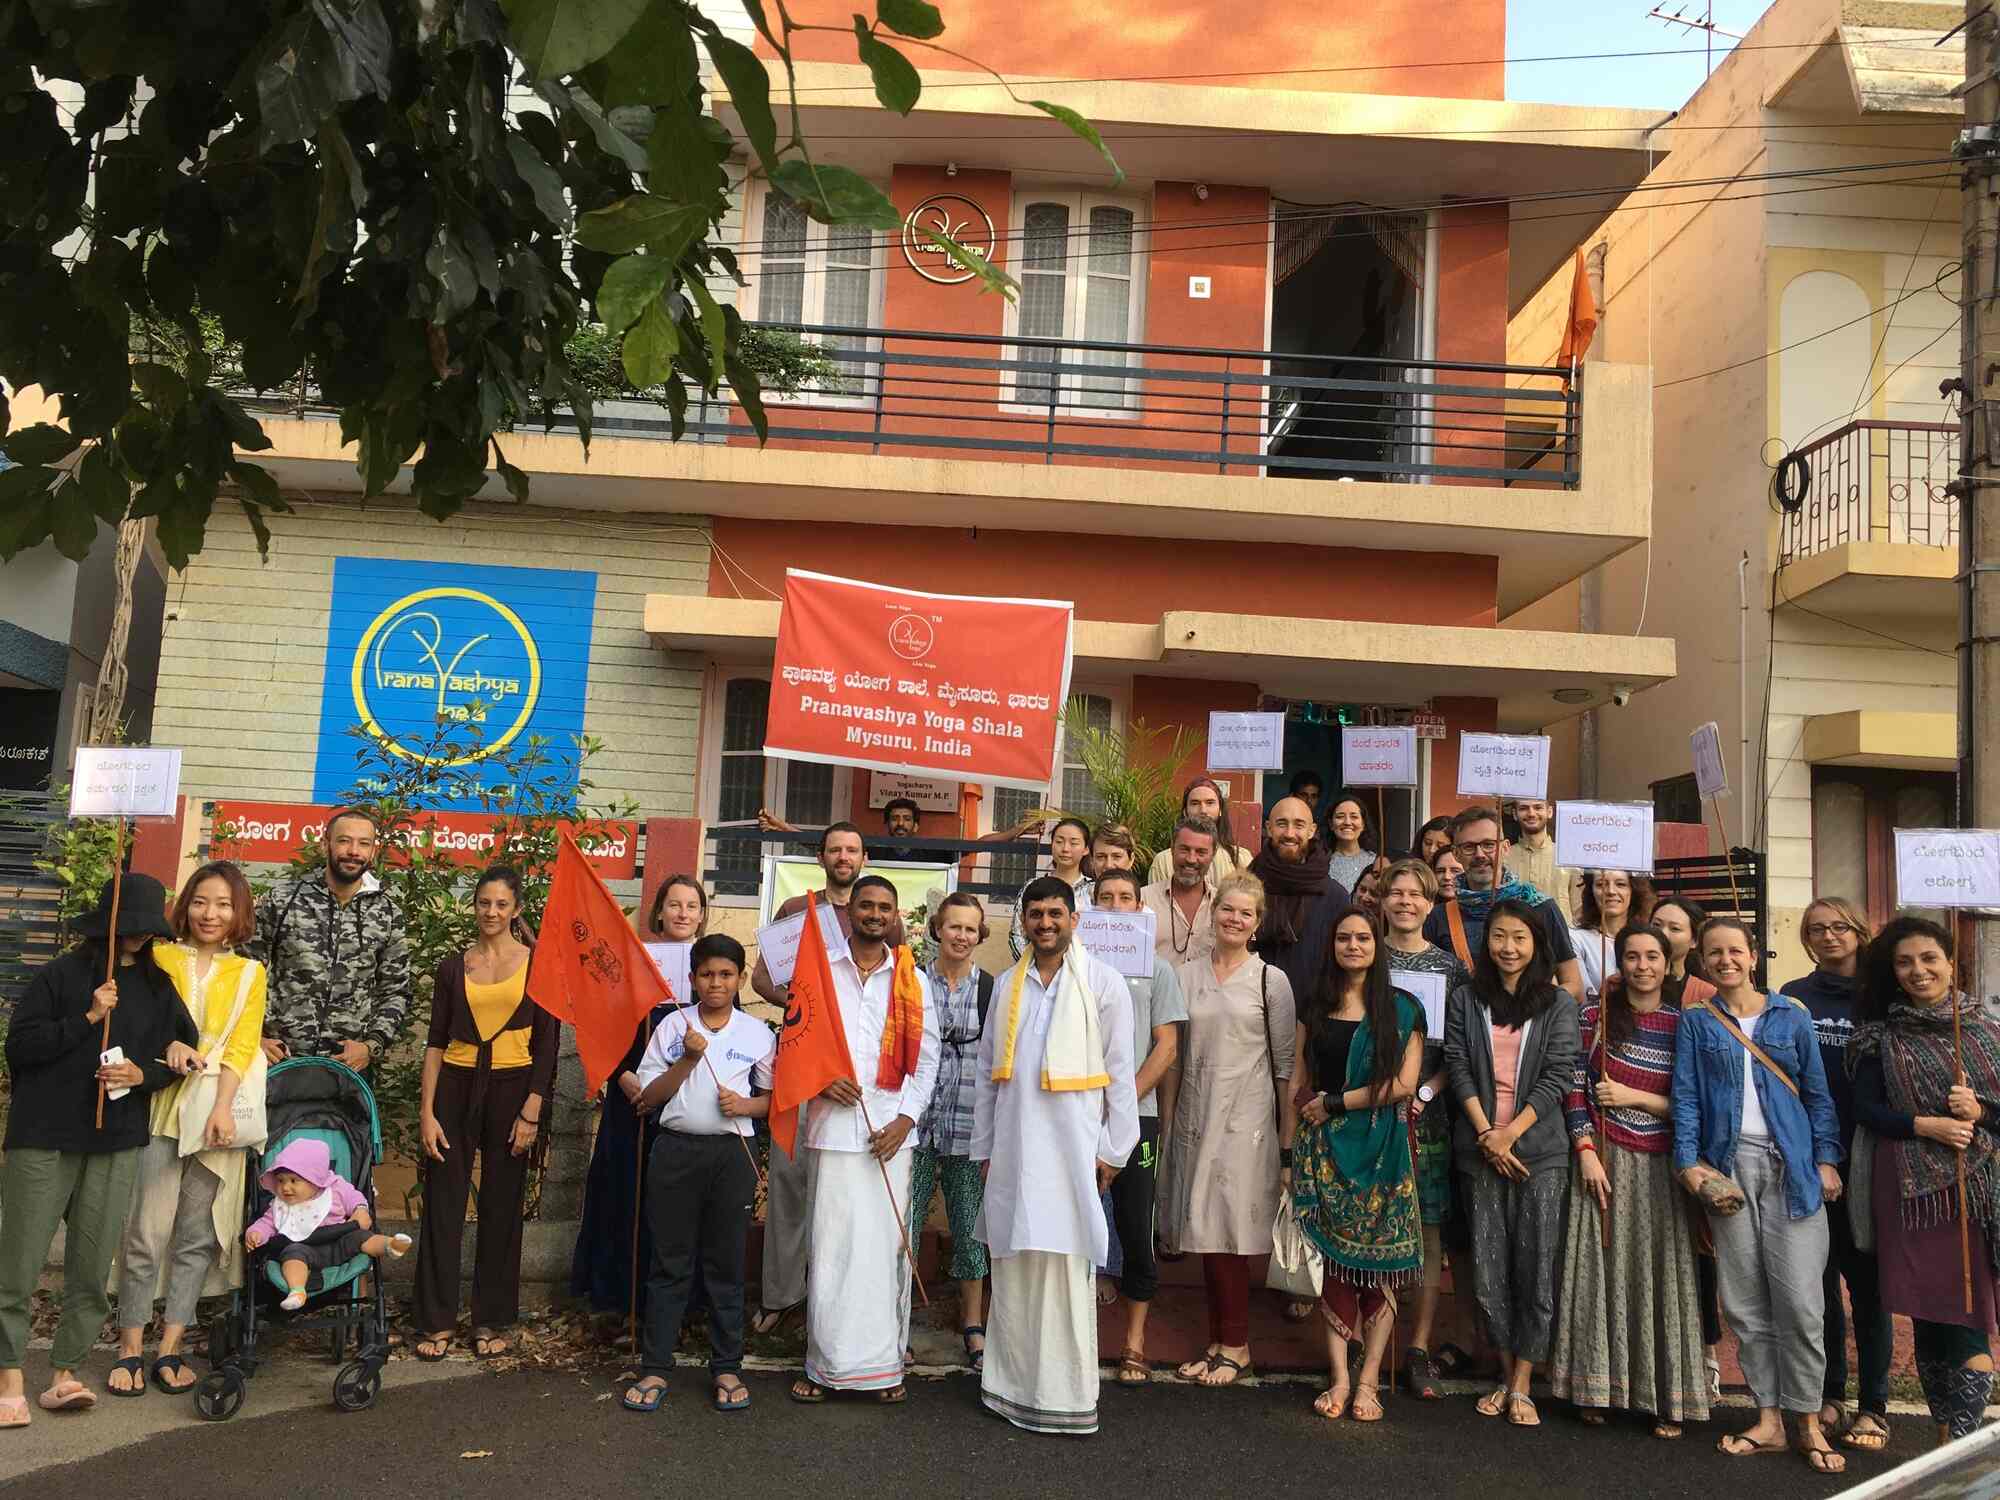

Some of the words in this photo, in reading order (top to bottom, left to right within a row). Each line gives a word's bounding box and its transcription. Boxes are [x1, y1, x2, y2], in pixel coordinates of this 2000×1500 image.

[932, 615, 943, 623] TM
[782, 665, 836, 693] ಪ್ರಾಣವಶ್ಯ
[844, 671, 891, 691] ಯೋಗ
[1008, 693, 1050, 711] ಭಾರತ
[800, 695, 917, 727] Pranavashya
[923, 710, 966, 733] Yoga
[971, 717, 1023, 738] Shala
[924, 735, 972, 757] India
[905, 790, 932, 799] Kumar
[433, 823, 495, 851] ರೋಗ
[1924, 874, 1977, 895] ಆರೋಗ್ಯ
[1083, 920, 1108, 930] ಯೋಗ
